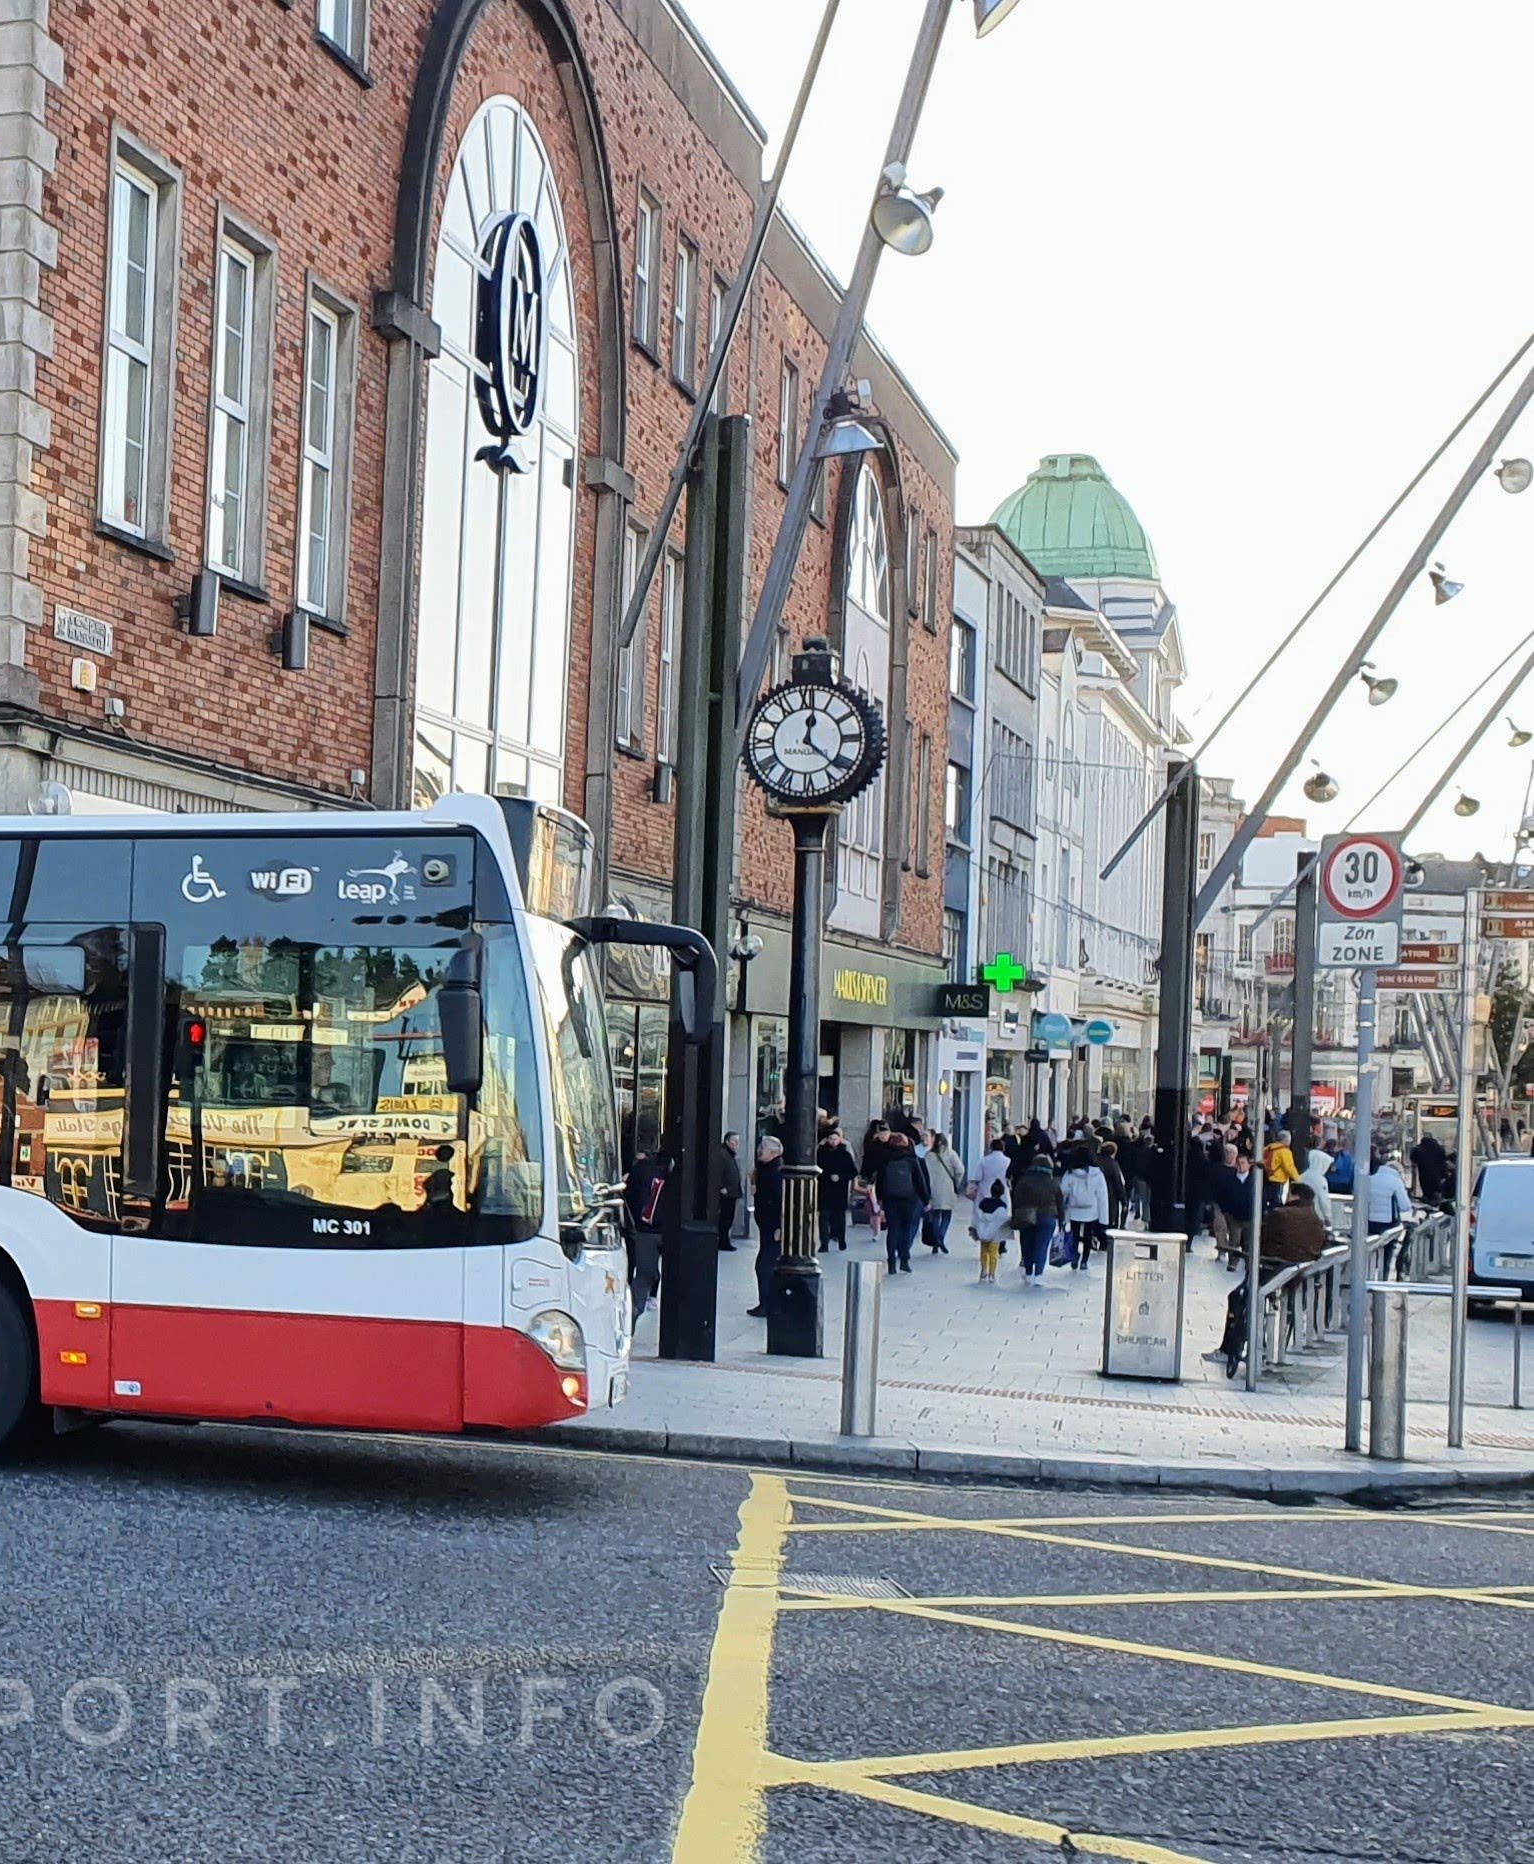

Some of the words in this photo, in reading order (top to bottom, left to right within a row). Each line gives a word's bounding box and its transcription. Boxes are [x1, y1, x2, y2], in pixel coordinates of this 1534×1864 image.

[1344, 851, 1379, 884] 30
[338, 879, 387, 905] leap
[1347, 889, 1373, 899] km/h
[1332, 946, 1384, 961] ZONE
[945, 992, 984, 1011] M&S
[312, 1217, 341, 1234] MC
[343, 1218, 371, 1236] 301
[1125, 1271, 1164, 1282] LITTER
